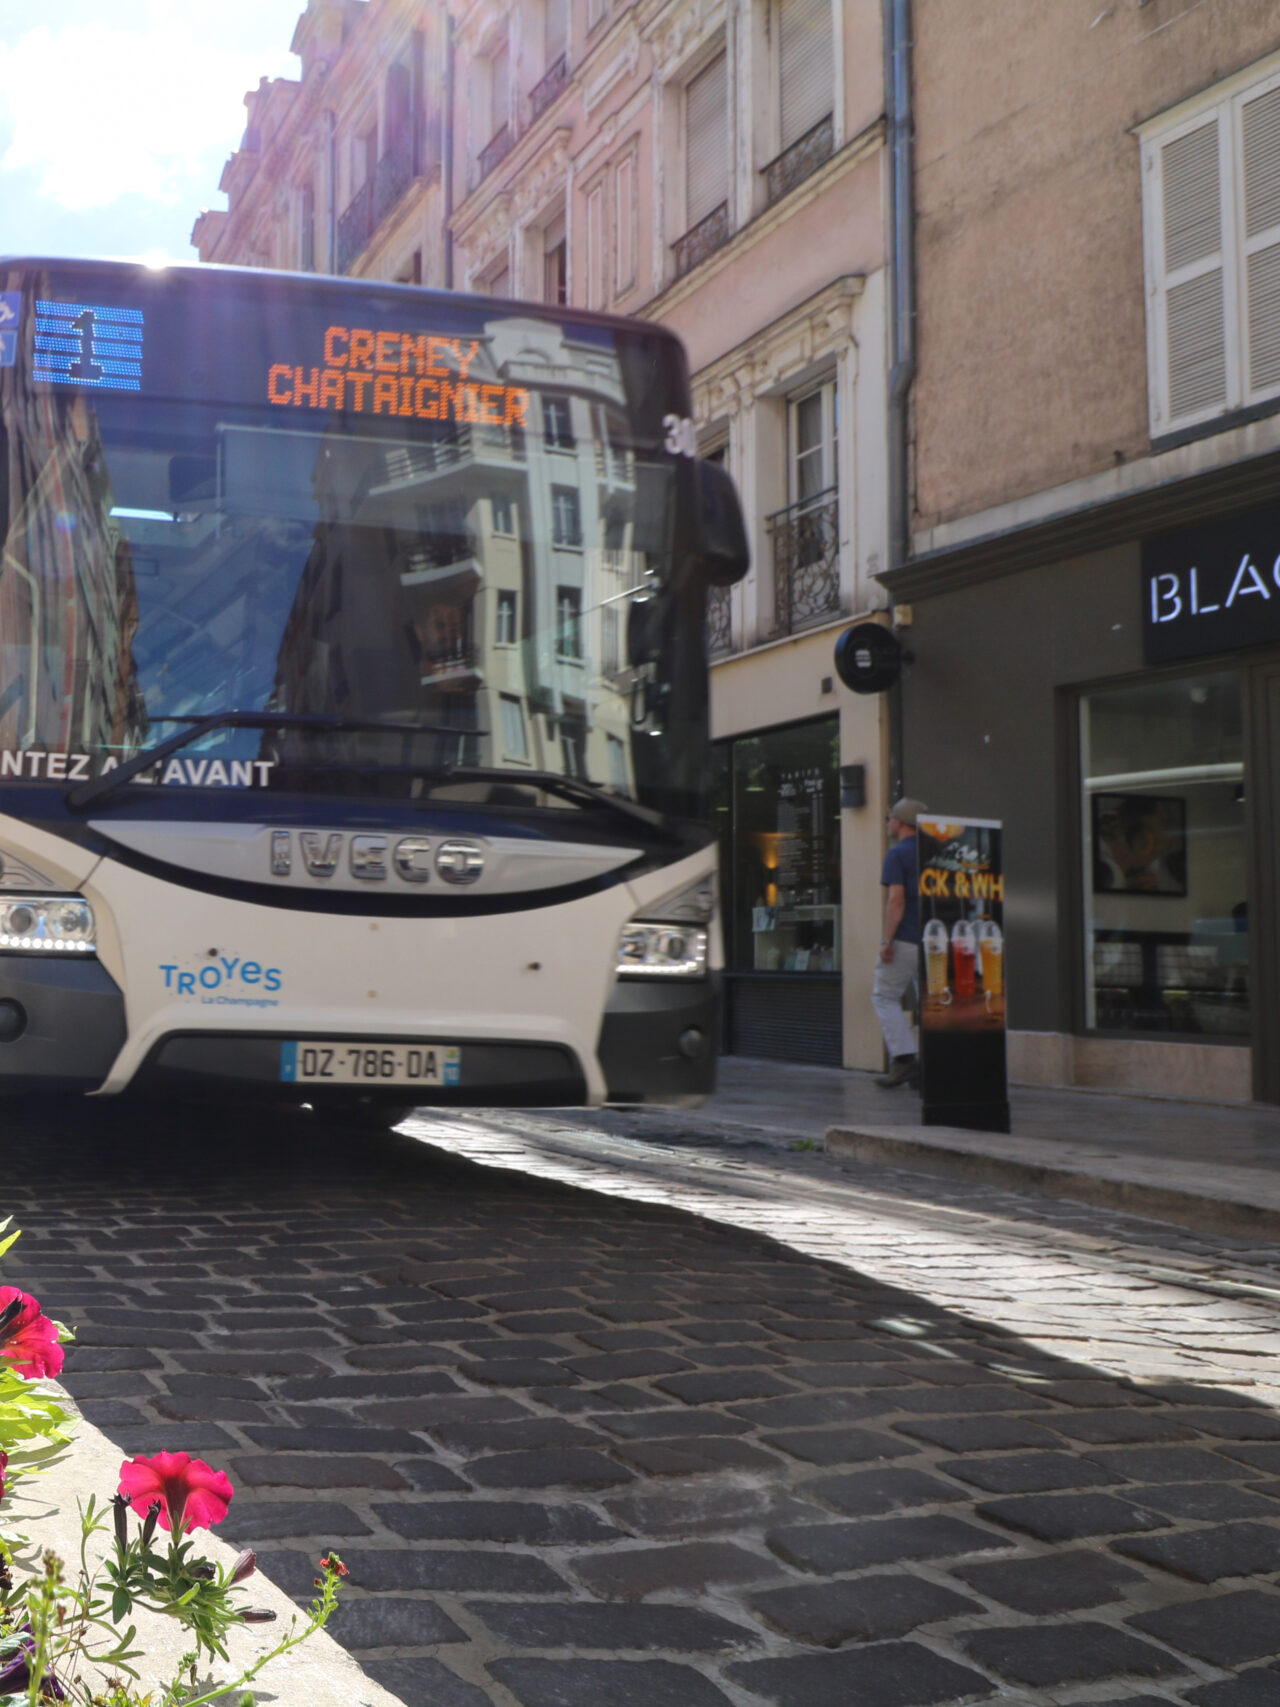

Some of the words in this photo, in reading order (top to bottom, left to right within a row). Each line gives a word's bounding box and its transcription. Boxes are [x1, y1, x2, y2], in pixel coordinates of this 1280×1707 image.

[68, 308, 105, 383] 1
[324, 326, 480, 379] CRENEY
[267, 363, 530, 428] CHATAIGNIER
[1150, 553, 1280, 624] BLA
[271, 830, 486, 885] IVECO
[954, 869, 971, 899] &
